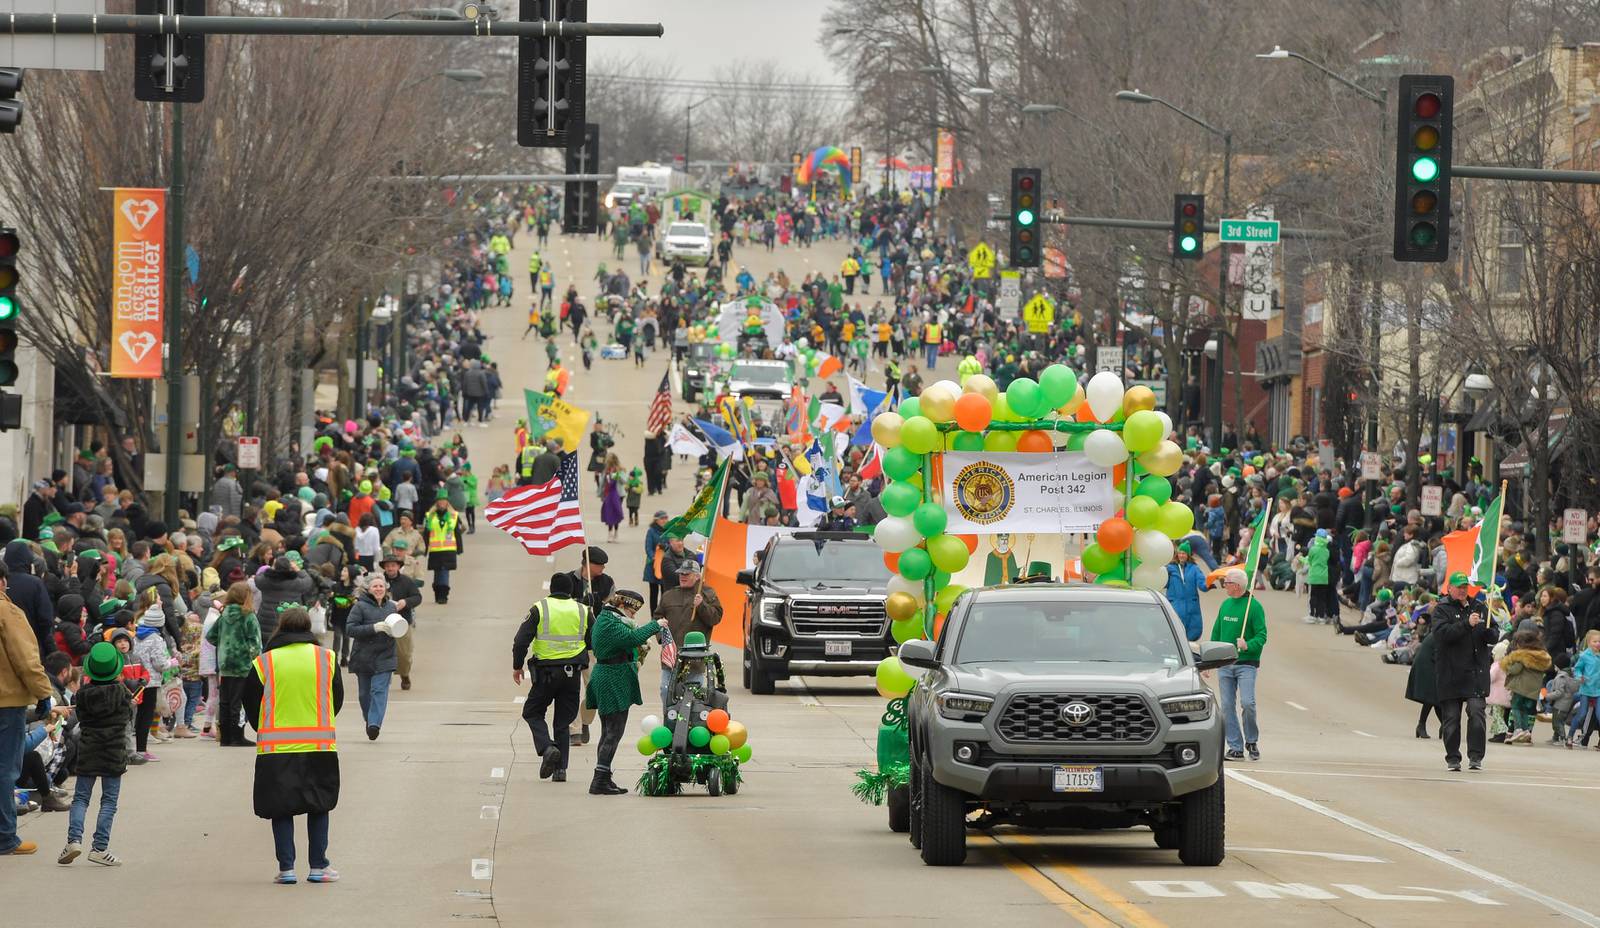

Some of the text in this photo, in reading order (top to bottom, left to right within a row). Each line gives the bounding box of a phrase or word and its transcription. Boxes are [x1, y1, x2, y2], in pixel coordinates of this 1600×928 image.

[1227, 224, 1273, 238] 3rd Street
[117, 241, 145, 320] random
[137, 240, 161, 322] matter
[1002, 288, 1018, 298] 20
[959, 466, 1008, 487] AMERICAN
[1017, 472, 1107, 482] American Legion
[977, 488, 990, 497] US
[1040, 484, 1086, 494] Post 342
[966, 508, 1003, 519] LEGION
[1073, 504, 1104, 513] ILLINOIS
[1571, 512, 1581, 520] NO
[818, 606, 859, 615] GMC
[1065, 773, 1095, 786] 17159
[1128, 880, 1510, 906] ONLY
